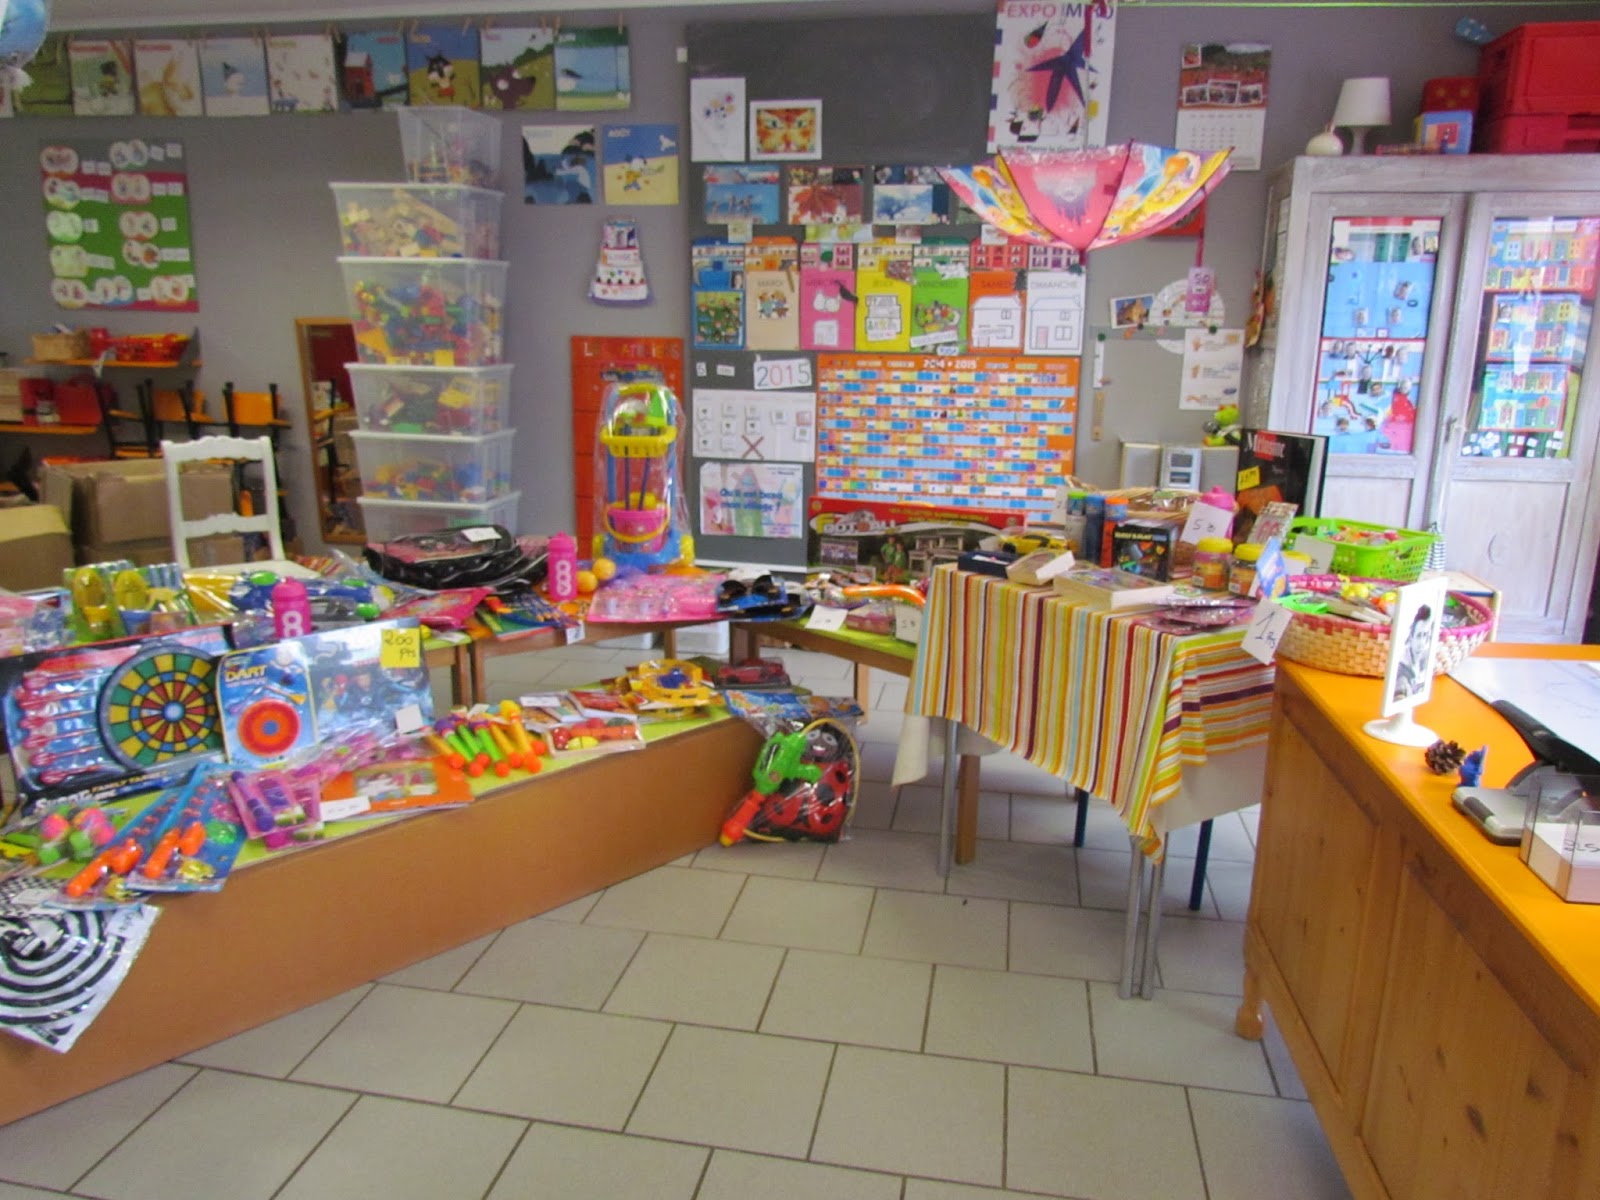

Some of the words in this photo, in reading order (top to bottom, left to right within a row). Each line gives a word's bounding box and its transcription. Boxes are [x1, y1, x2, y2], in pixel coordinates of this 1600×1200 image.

[1007, 4, 1056, 18] EXPO
[756, 361, 810, 387] 2015
[384, 630, 414, 646] 200
[224, 664, 268, 682] DART
